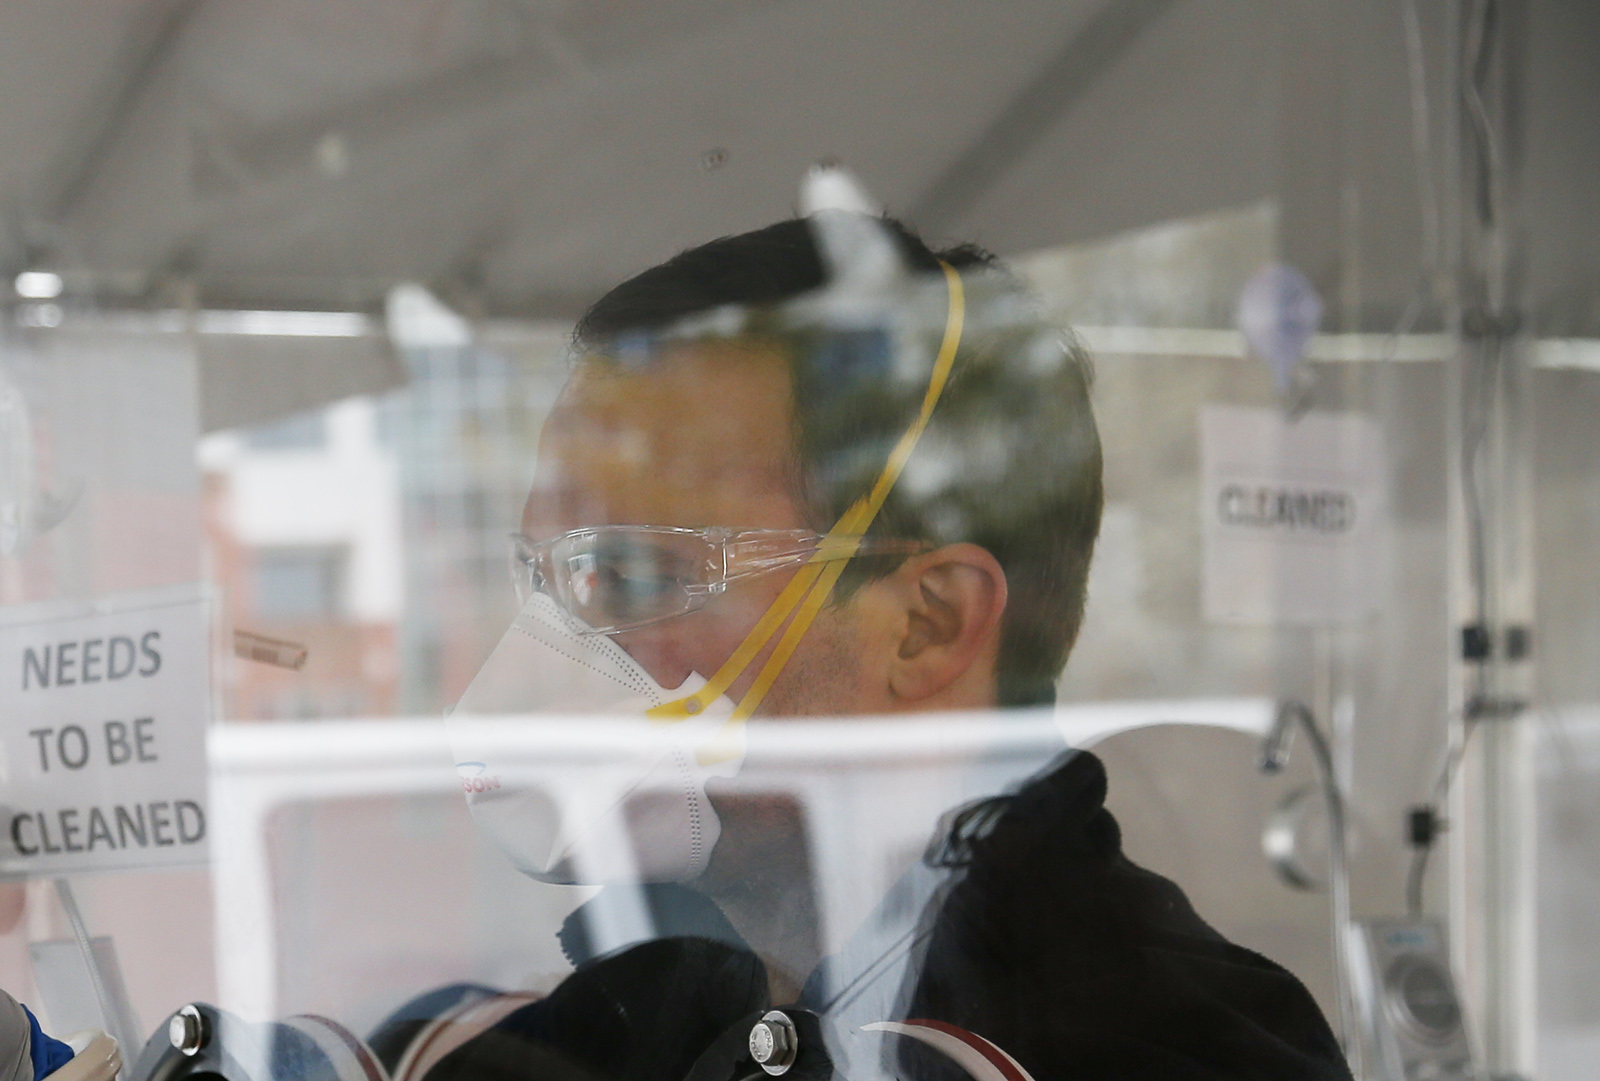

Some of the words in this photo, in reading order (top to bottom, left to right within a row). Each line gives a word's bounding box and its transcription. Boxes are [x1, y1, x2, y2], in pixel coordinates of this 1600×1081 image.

[22, 630, 162, 691] NEEDS
[29, 723, 90, 772] TO
[103, 716, 159, 767] BE
[10, 800, 207, 857] CLEANED
